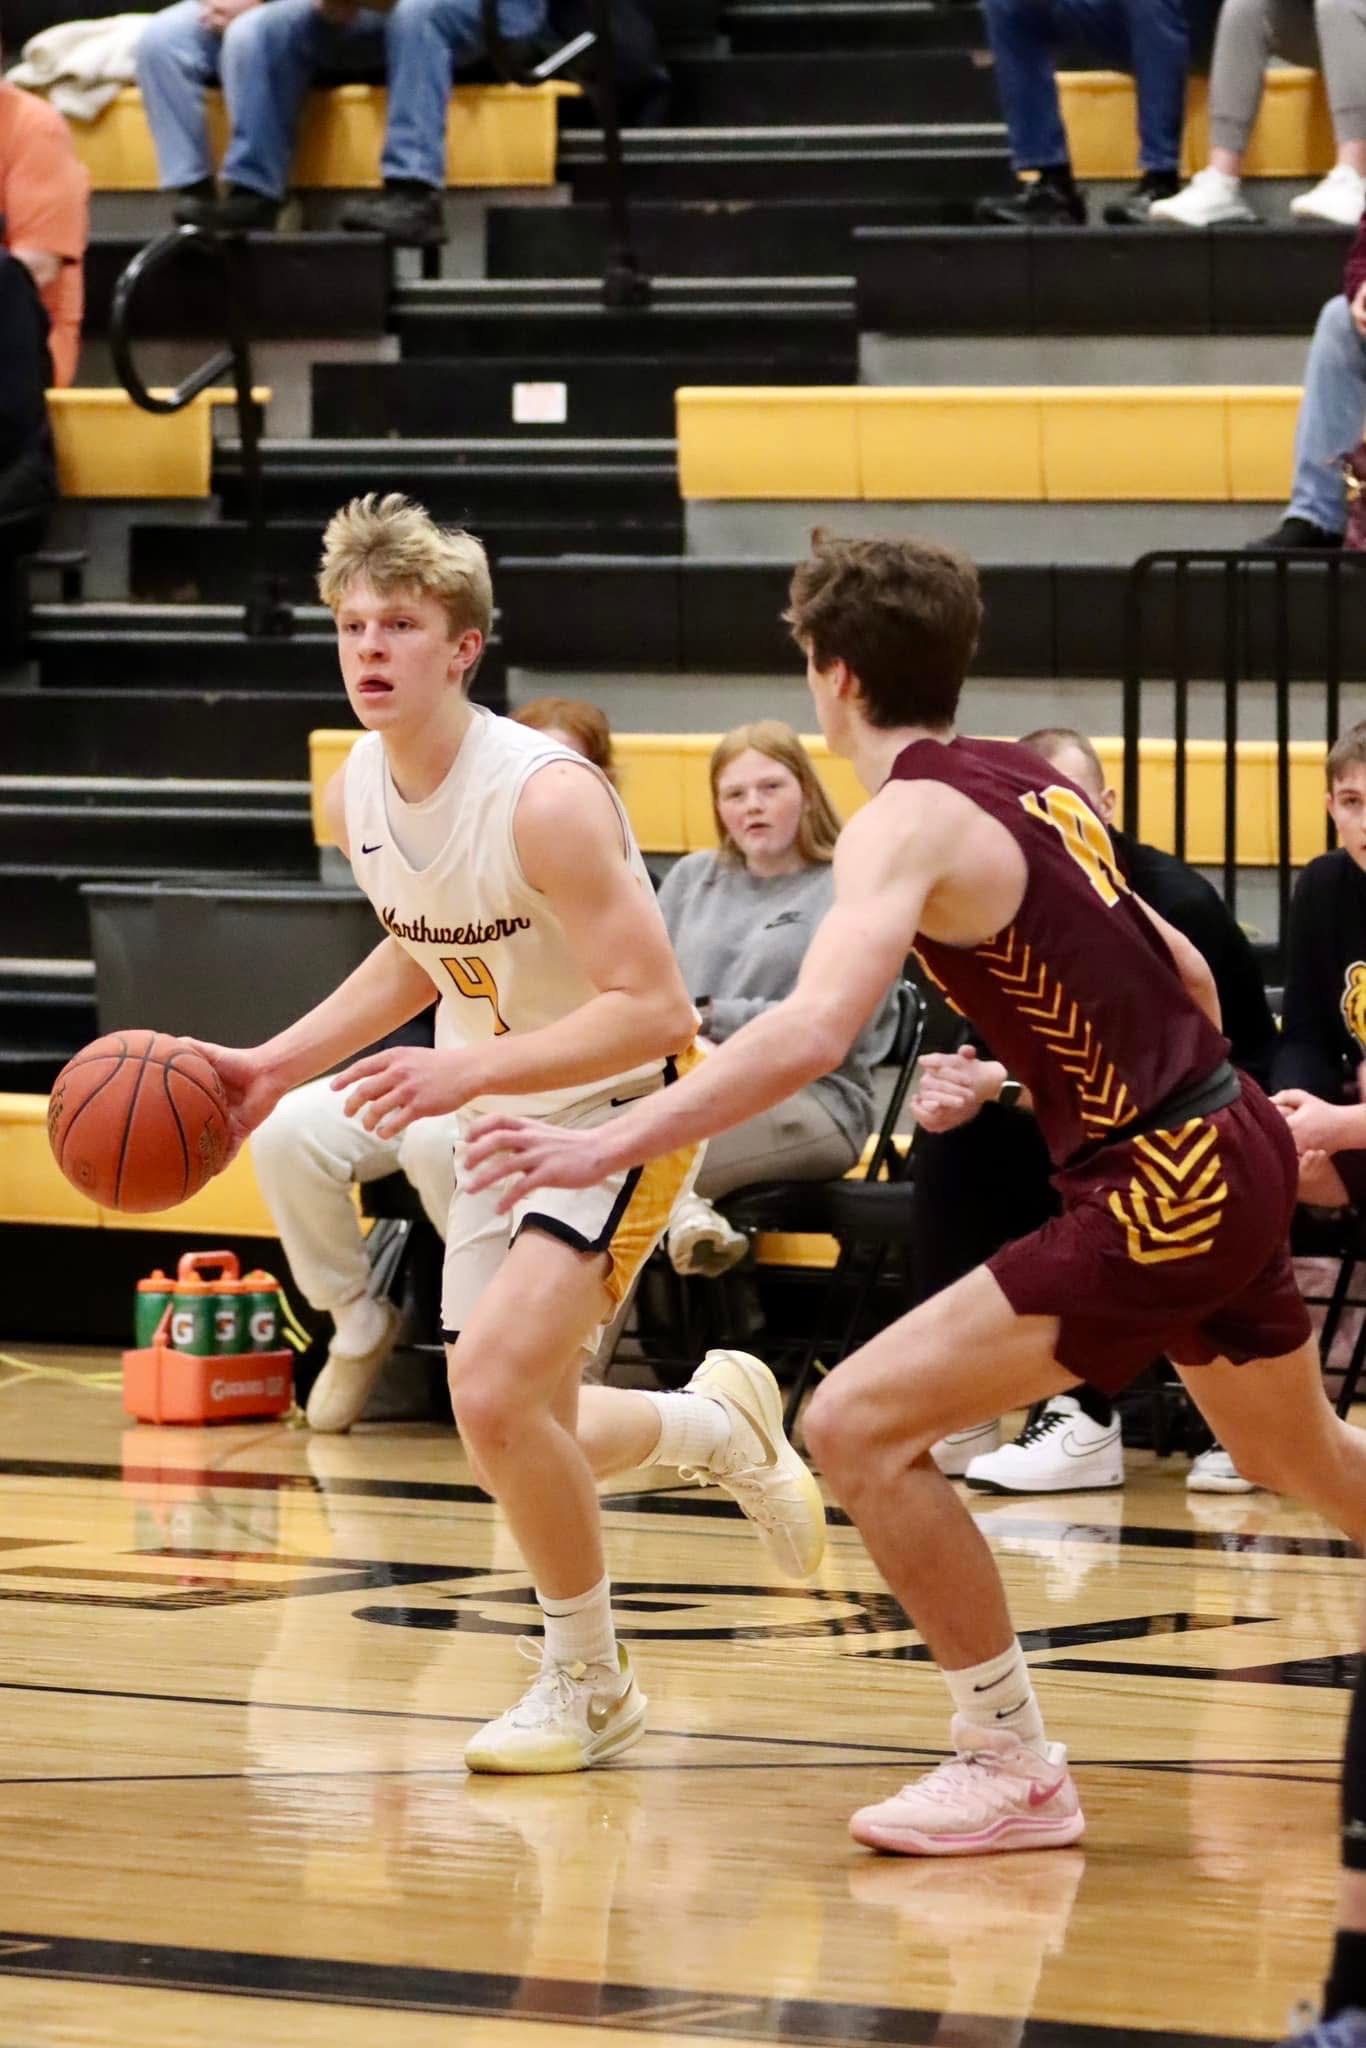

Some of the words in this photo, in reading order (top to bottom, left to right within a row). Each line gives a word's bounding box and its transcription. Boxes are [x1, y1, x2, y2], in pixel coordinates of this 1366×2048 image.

[382, 906, 531, 945] Northwestern
[440, 956, 511, 1036] 4
[171, 1312, 194, 1345] G
[249, 1312, 275, 1342] G
